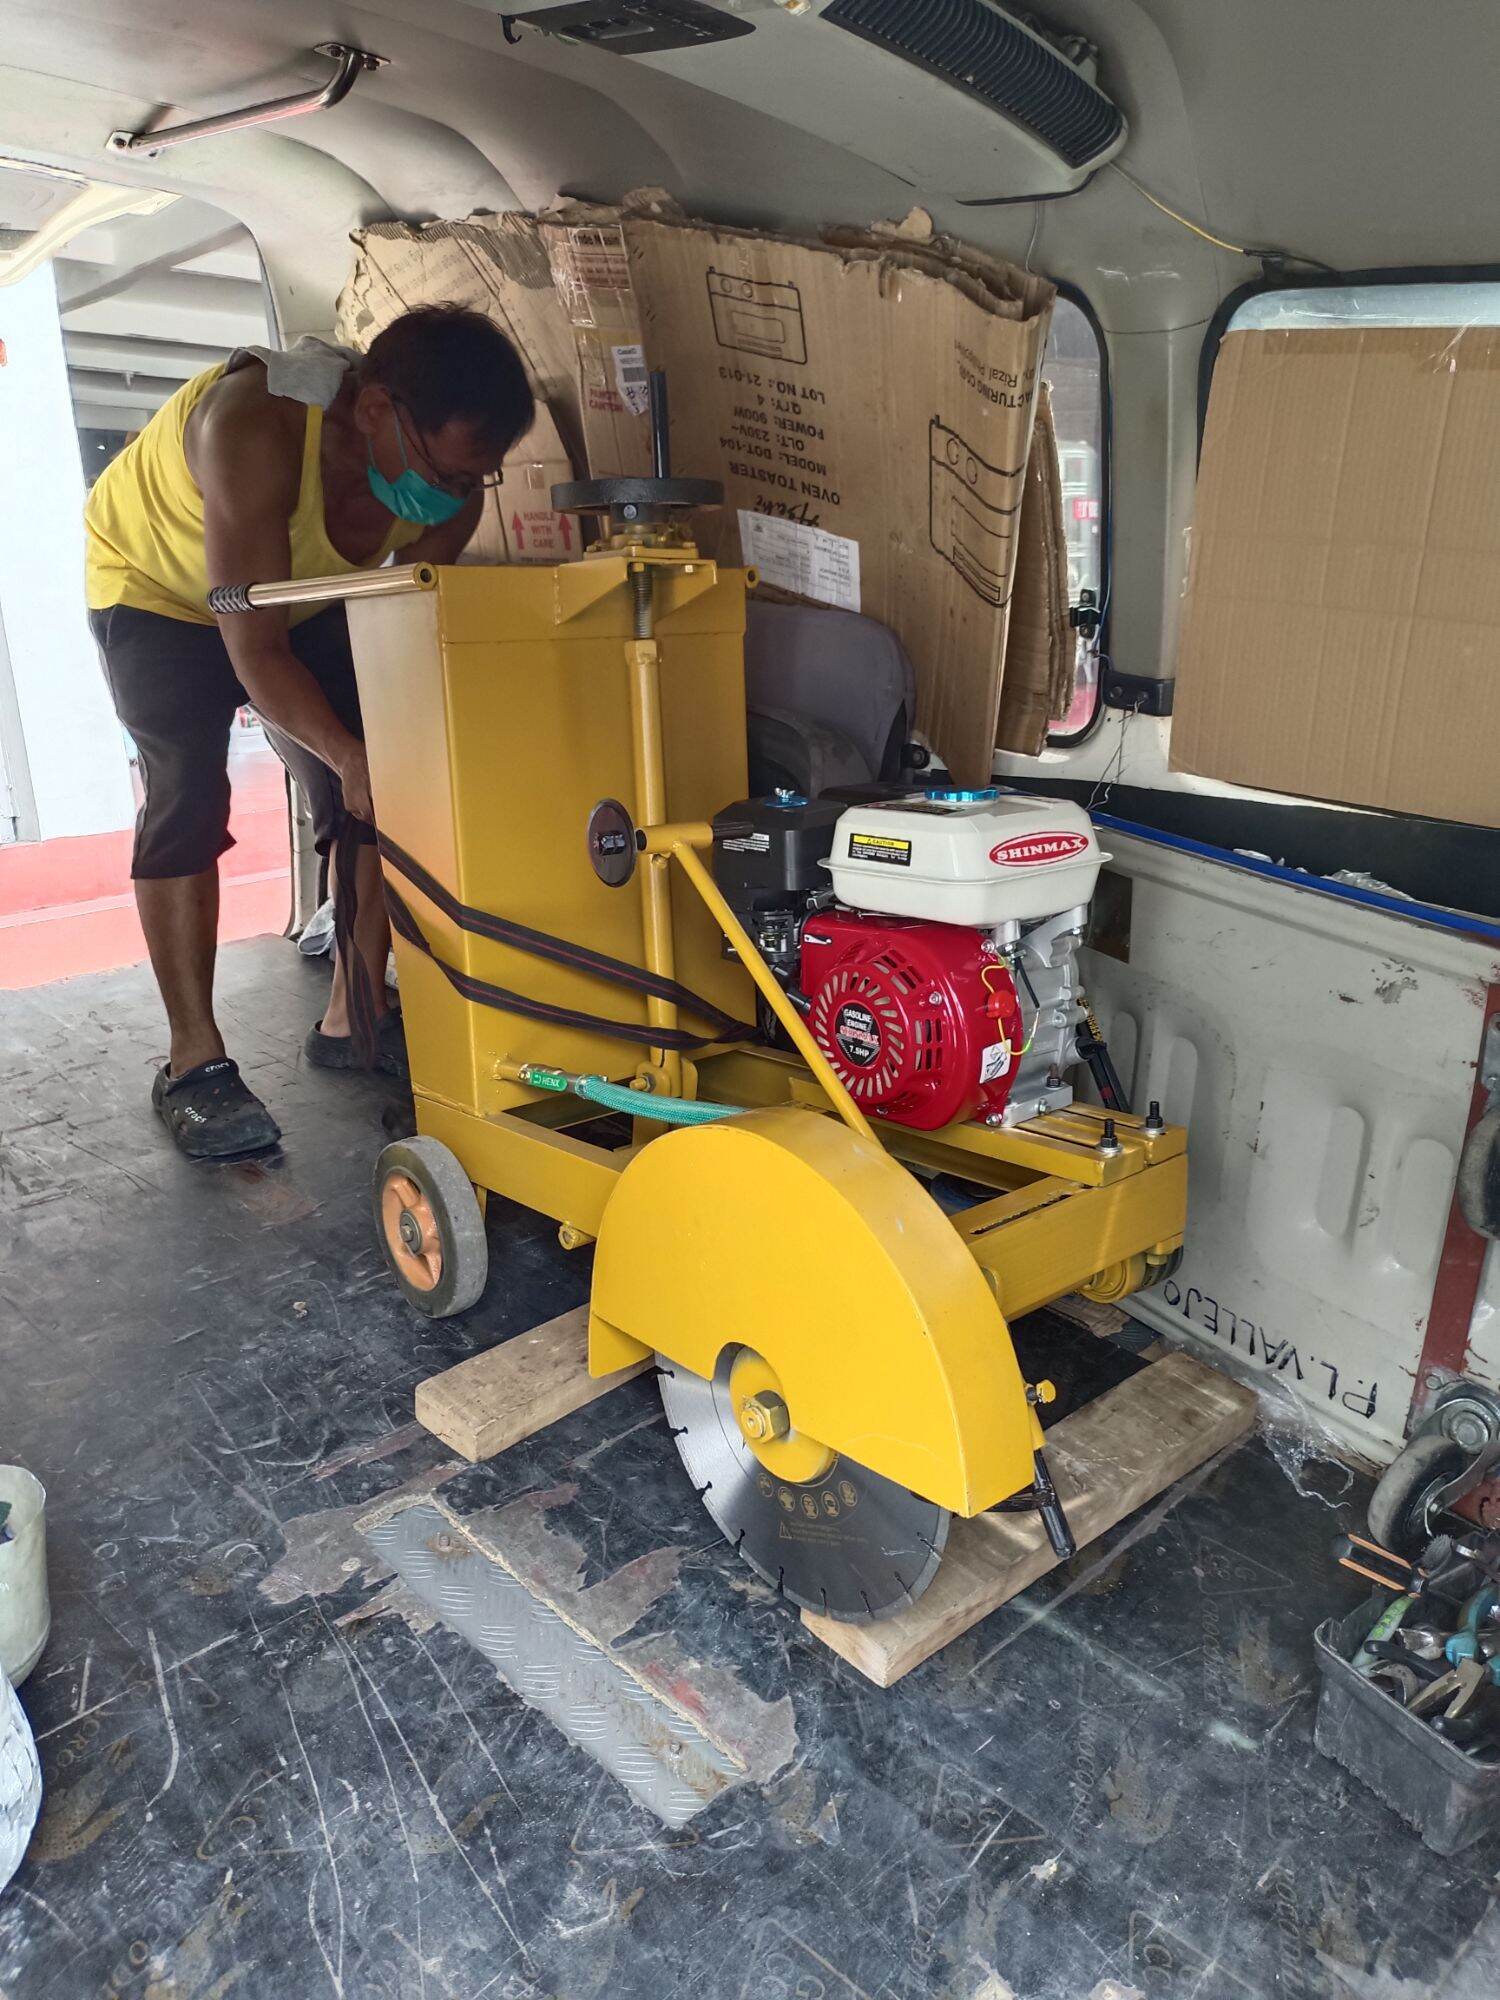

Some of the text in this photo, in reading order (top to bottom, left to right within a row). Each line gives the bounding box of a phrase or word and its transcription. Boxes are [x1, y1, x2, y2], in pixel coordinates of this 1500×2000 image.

[717, 366, 826, 405] LOT NO.: 21-013
[989, 367, 1018, 388] Rizal
[756, 394, 802, 415] QTY: 4
[733, 405, 825, 441] POWER: 900W
[720, 436, 827, 476] MODEL: DOT-104
[729, 460, 841, 506] OVEN TOASTER
[523, 511, 557, 521] HANDLE
[531, 525, 553, 536] WITH
[533, 539, 555, 549] CARE
[996, 837, 1084, 861] SHINMAX
[843, 1008, 872, 1023] GASOLINE
[846, 1018, 868, 1032] ENGINE
[849, 1045, 870, 1058] 7.5HP
[205, 1061, 230, 1073] crocs
[184, 1106, 208, 1124] crocs
